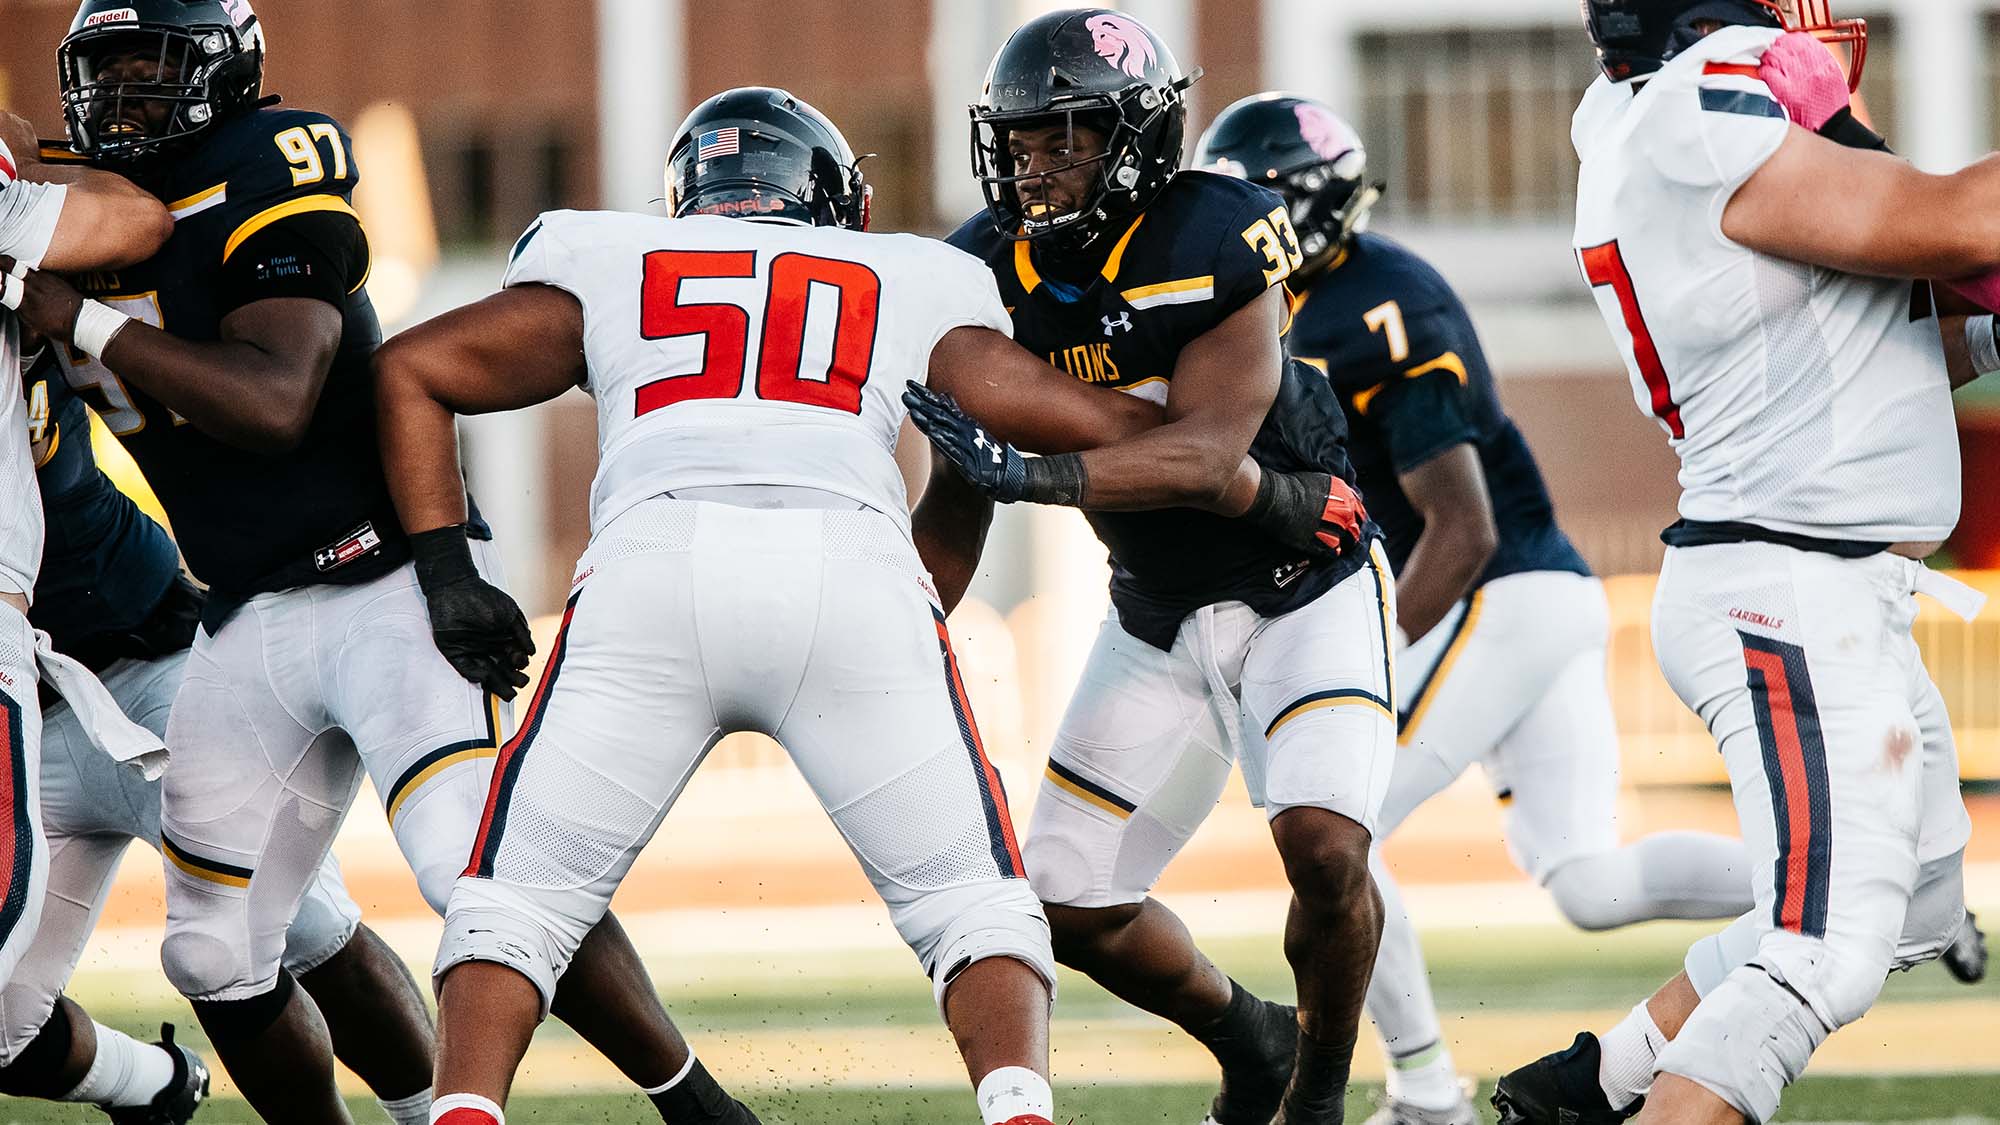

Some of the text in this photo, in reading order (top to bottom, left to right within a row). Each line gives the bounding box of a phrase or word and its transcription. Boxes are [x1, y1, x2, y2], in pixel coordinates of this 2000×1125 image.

[88, 10, 129, 25] Riddell
[273, 123, 347, 187] 97
[1241, 206, 1304, 288] 33
[634, 249, 882, 418] 50
[1362, 299, 1409, 363] 7
[1729, 607, 1784, 630] CARDINALS
